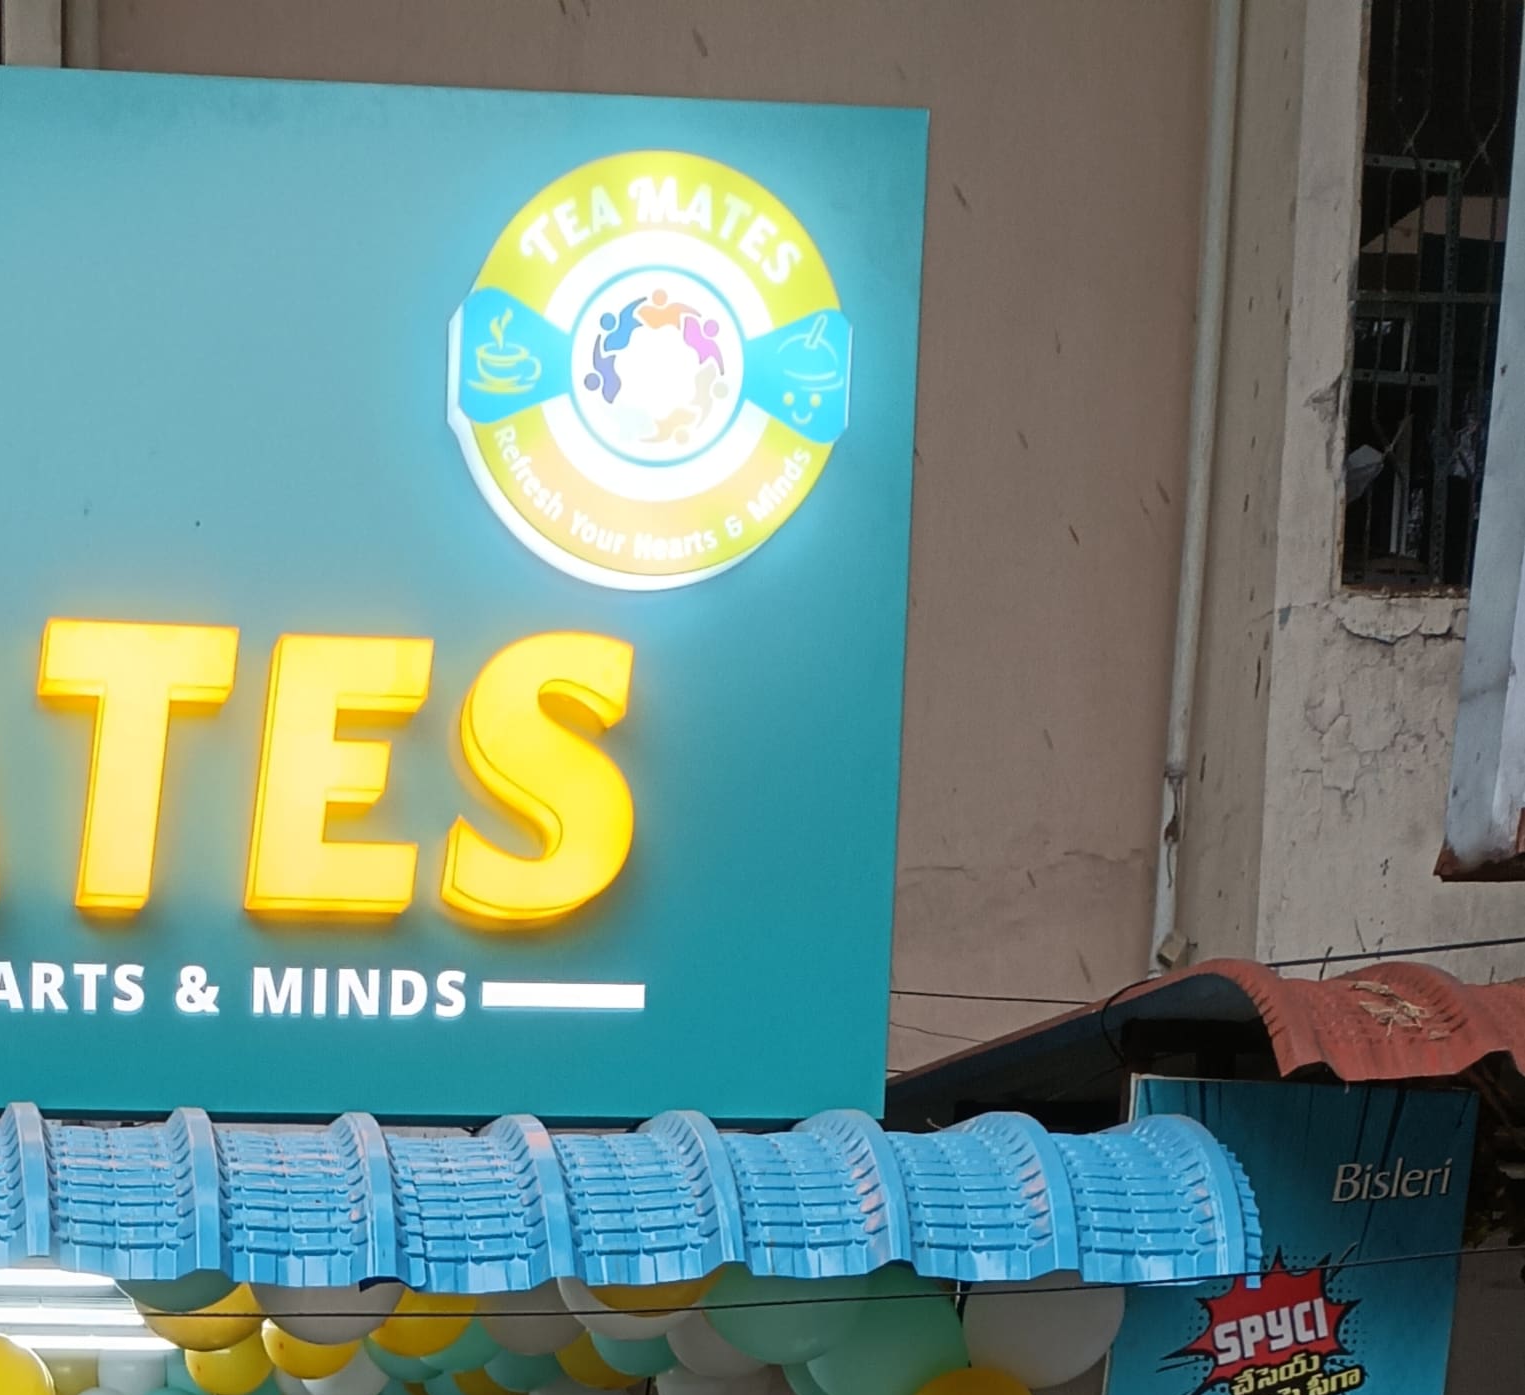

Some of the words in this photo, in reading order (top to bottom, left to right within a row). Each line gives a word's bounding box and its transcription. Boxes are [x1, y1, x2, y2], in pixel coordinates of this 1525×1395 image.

[519, 184, 624, 265] TEA
[627, 175, 803, 286] MATES
[494, 424, 566, 523] Refresh
[568, 508, 628, 556] Your
[631, 527, 719, 562] Hearts
[723, 514, 745, 540] &
[746, 447, 813, 525] Minds
[174, 965, 221, 1018] &
[250, 965, 468, 1019] MINDS
[1332, 1157, 1453, 1203] Bisleri
[1213, 1297, 1329, 1366] SPYCI
